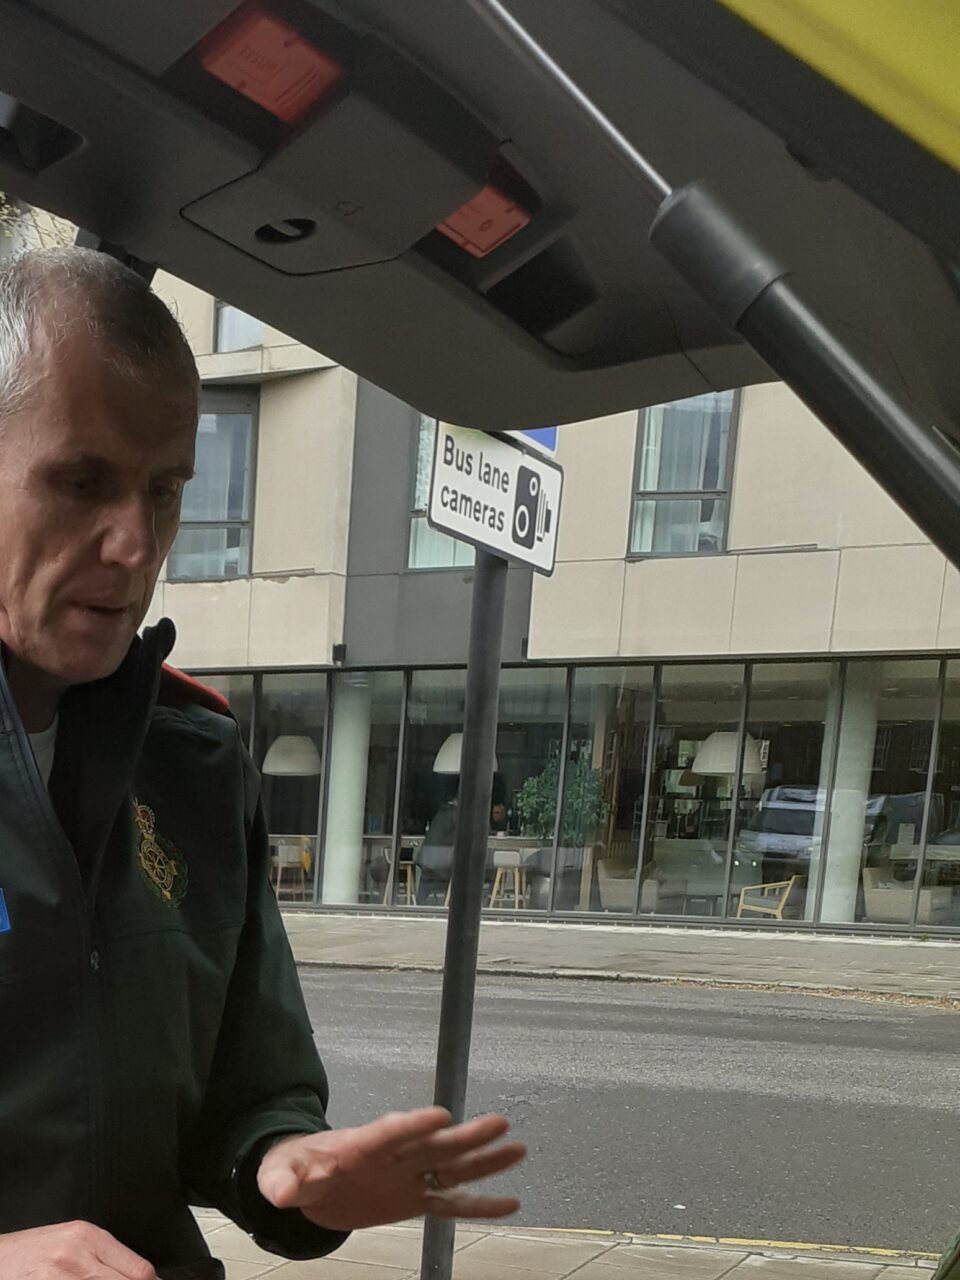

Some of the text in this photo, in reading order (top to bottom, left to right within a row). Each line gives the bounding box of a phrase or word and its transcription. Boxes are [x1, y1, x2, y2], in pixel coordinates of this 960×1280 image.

[443, 434, 510, 493] Bus lane
[440, 485, 505, 532] cameras
